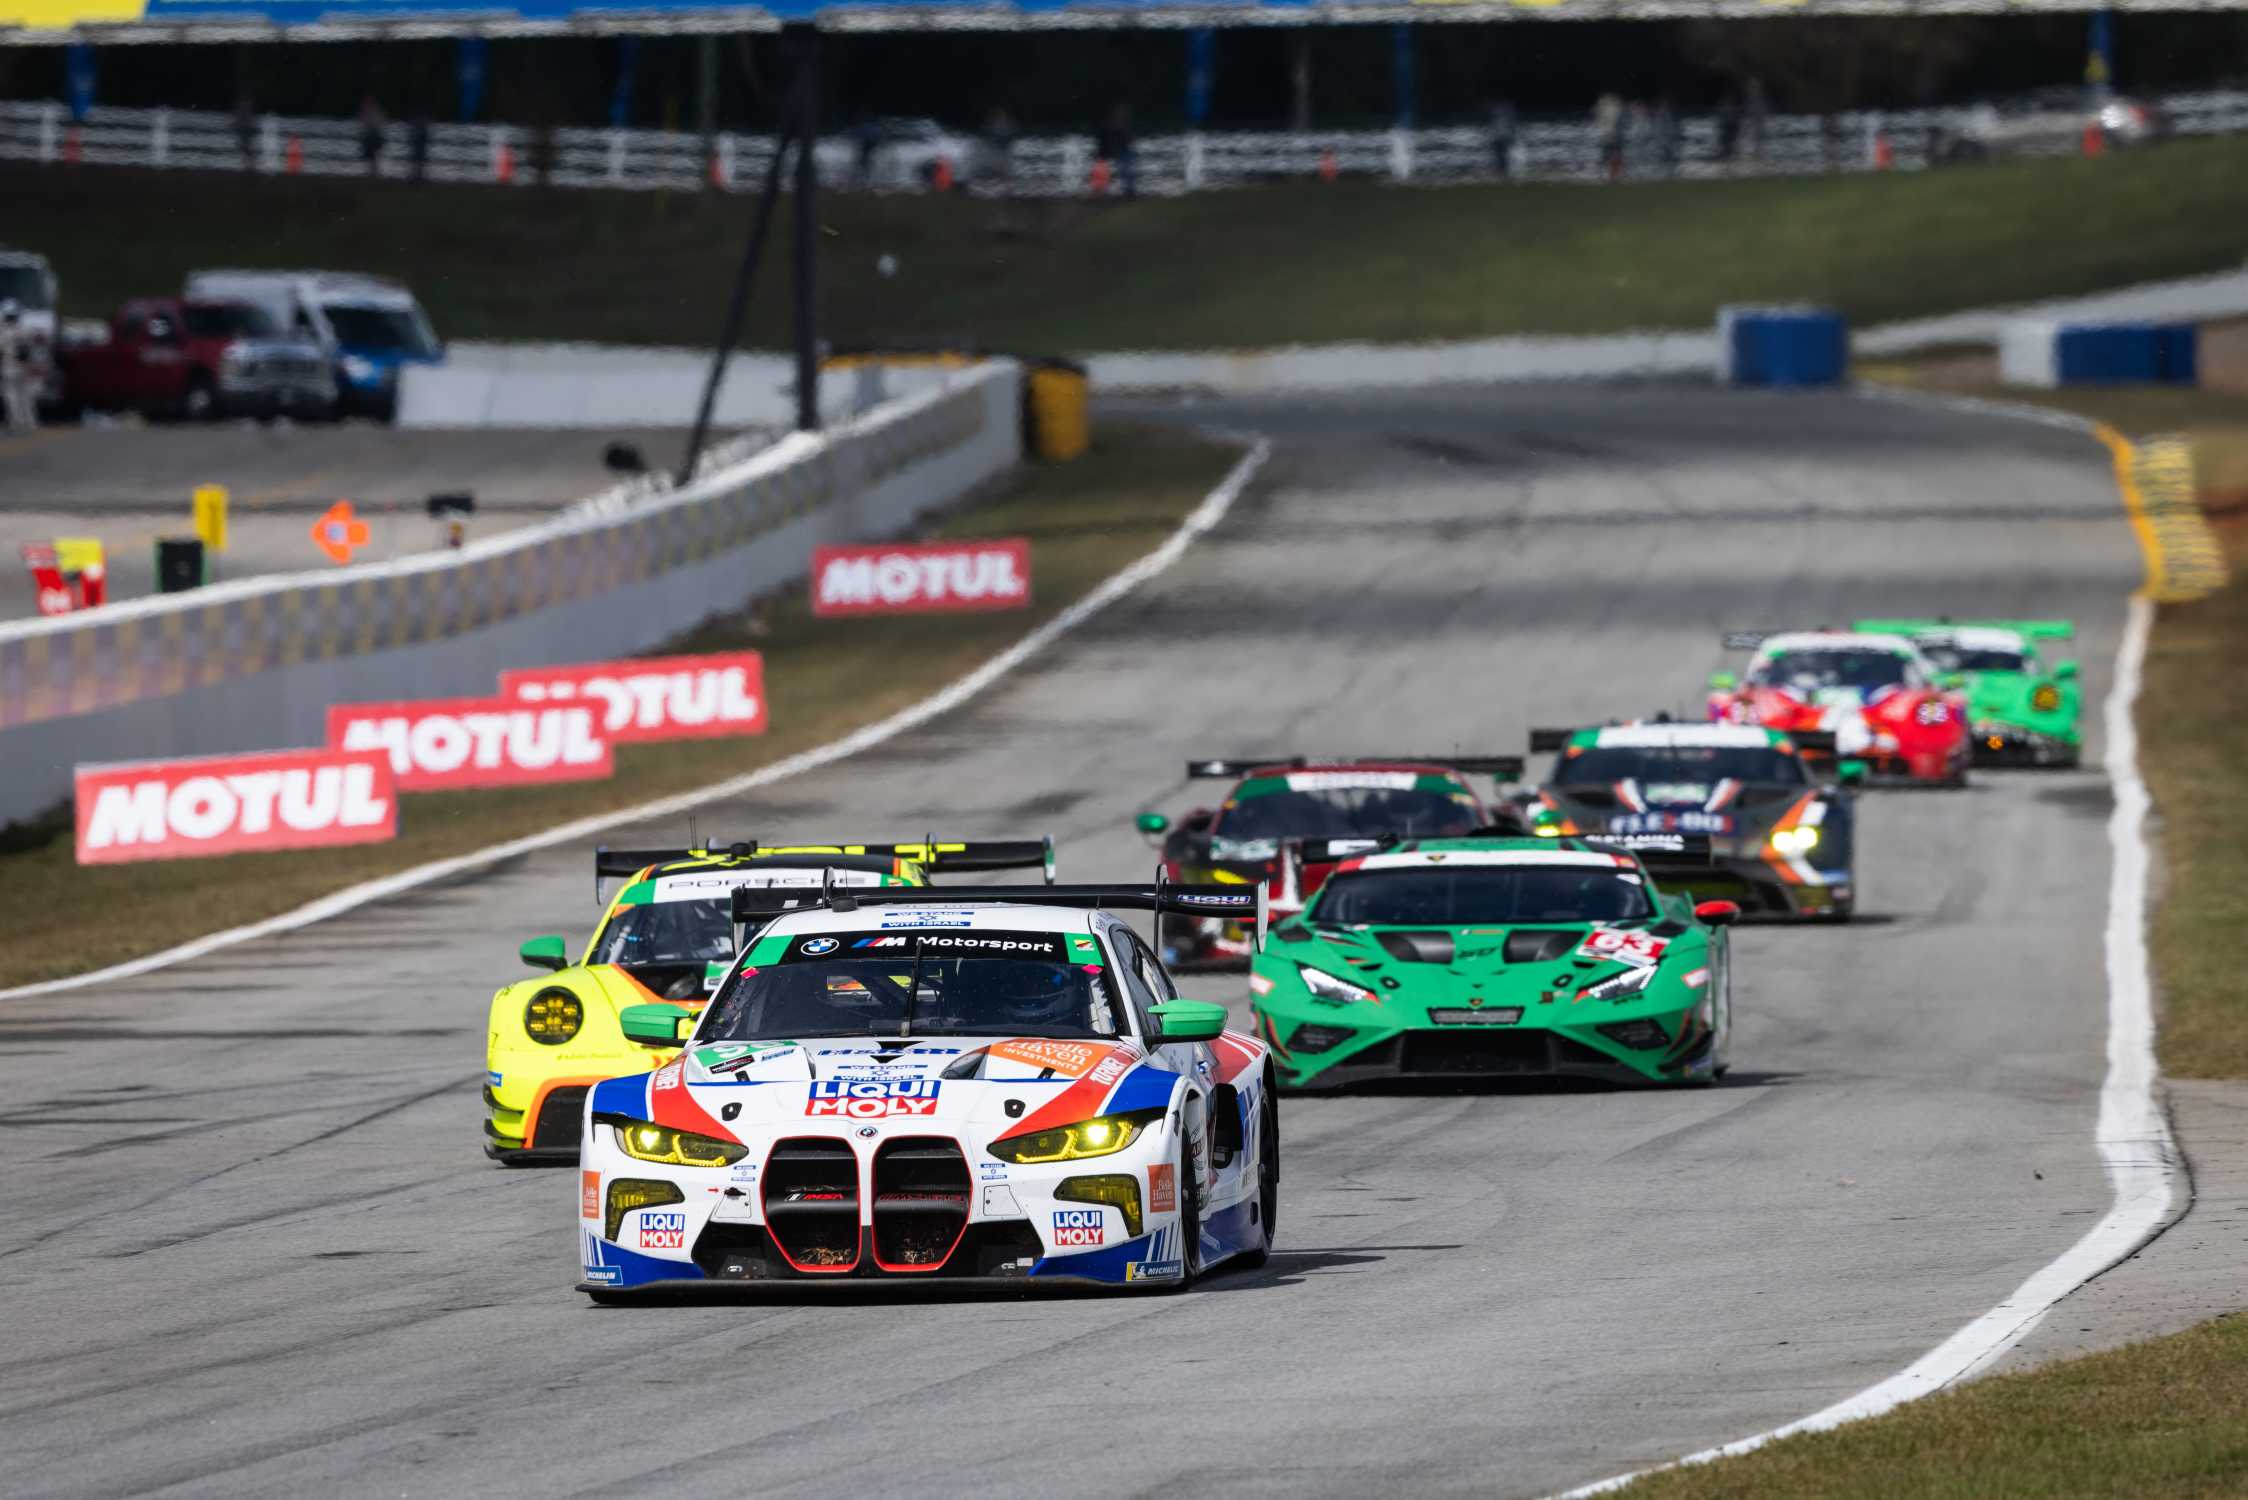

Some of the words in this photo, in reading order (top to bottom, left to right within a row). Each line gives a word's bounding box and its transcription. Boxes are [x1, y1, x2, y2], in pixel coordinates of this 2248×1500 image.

[821, 551, 1025, 604] MOTUL
[518, 667, 758, 731] OTUL
[85, 763, 387, 849] MOTUL
[917, 936, 1054, 953] Motorsport
[1003, 1047, 1079, 1072] INVESTMENTS
[815, 1081, 935, 1099] LIQUI
[811, 1098, 936, 1117] MOLY
[642, 1214, 685, 1231] LIQUI
[1055, 1212, 1102, 1229] LIQUI
[641, 1231, 685, 1247] MOLY
[1056, 1229, 1103, 1245] MOLY
